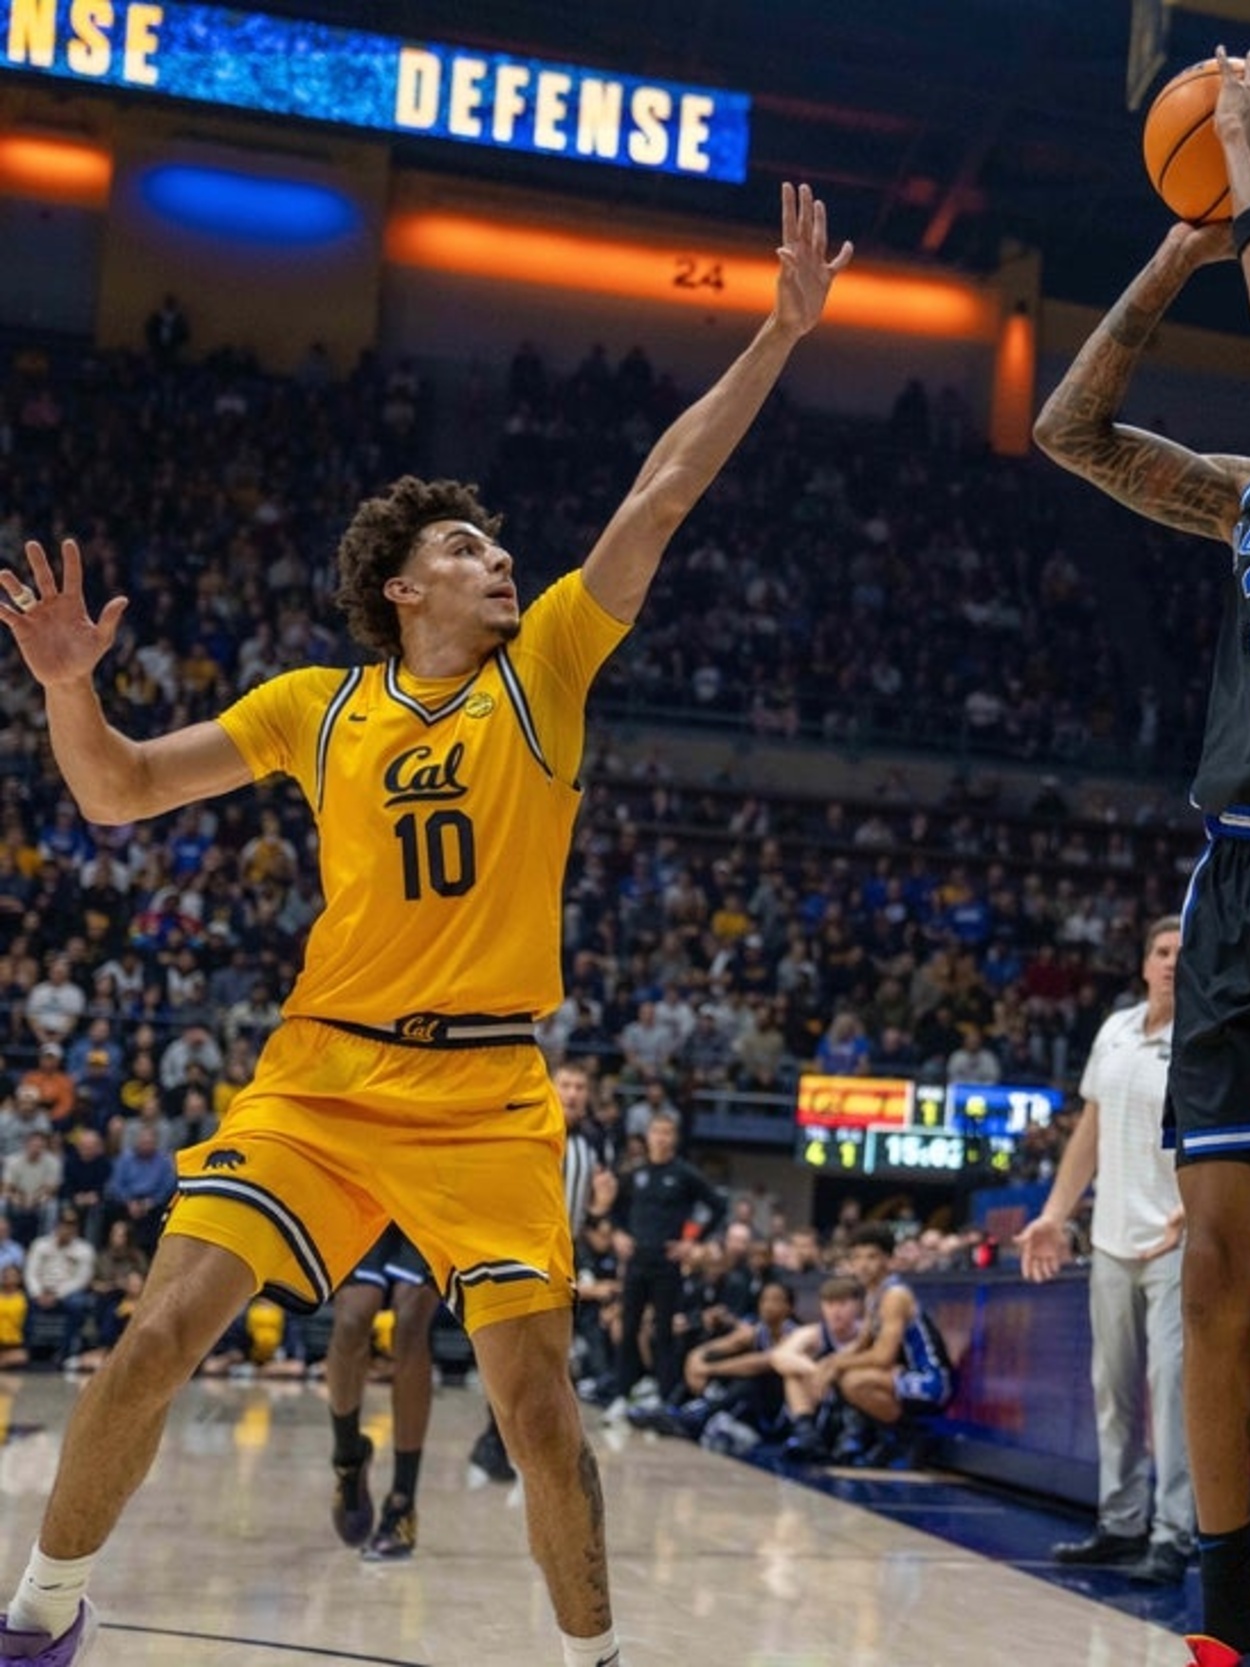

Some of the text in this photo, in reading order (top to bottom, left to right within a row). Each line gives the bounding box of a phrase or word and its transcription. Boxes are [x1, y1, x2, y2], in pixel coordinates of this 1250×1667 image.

[396, 48, 714, 172] DEFENSE
[671, 257, 726, 293] 24
[383, 740, 469, 808] Cal
[393, 808, 477, 901] 10
[402, 1016, 436, 1042] Cal
